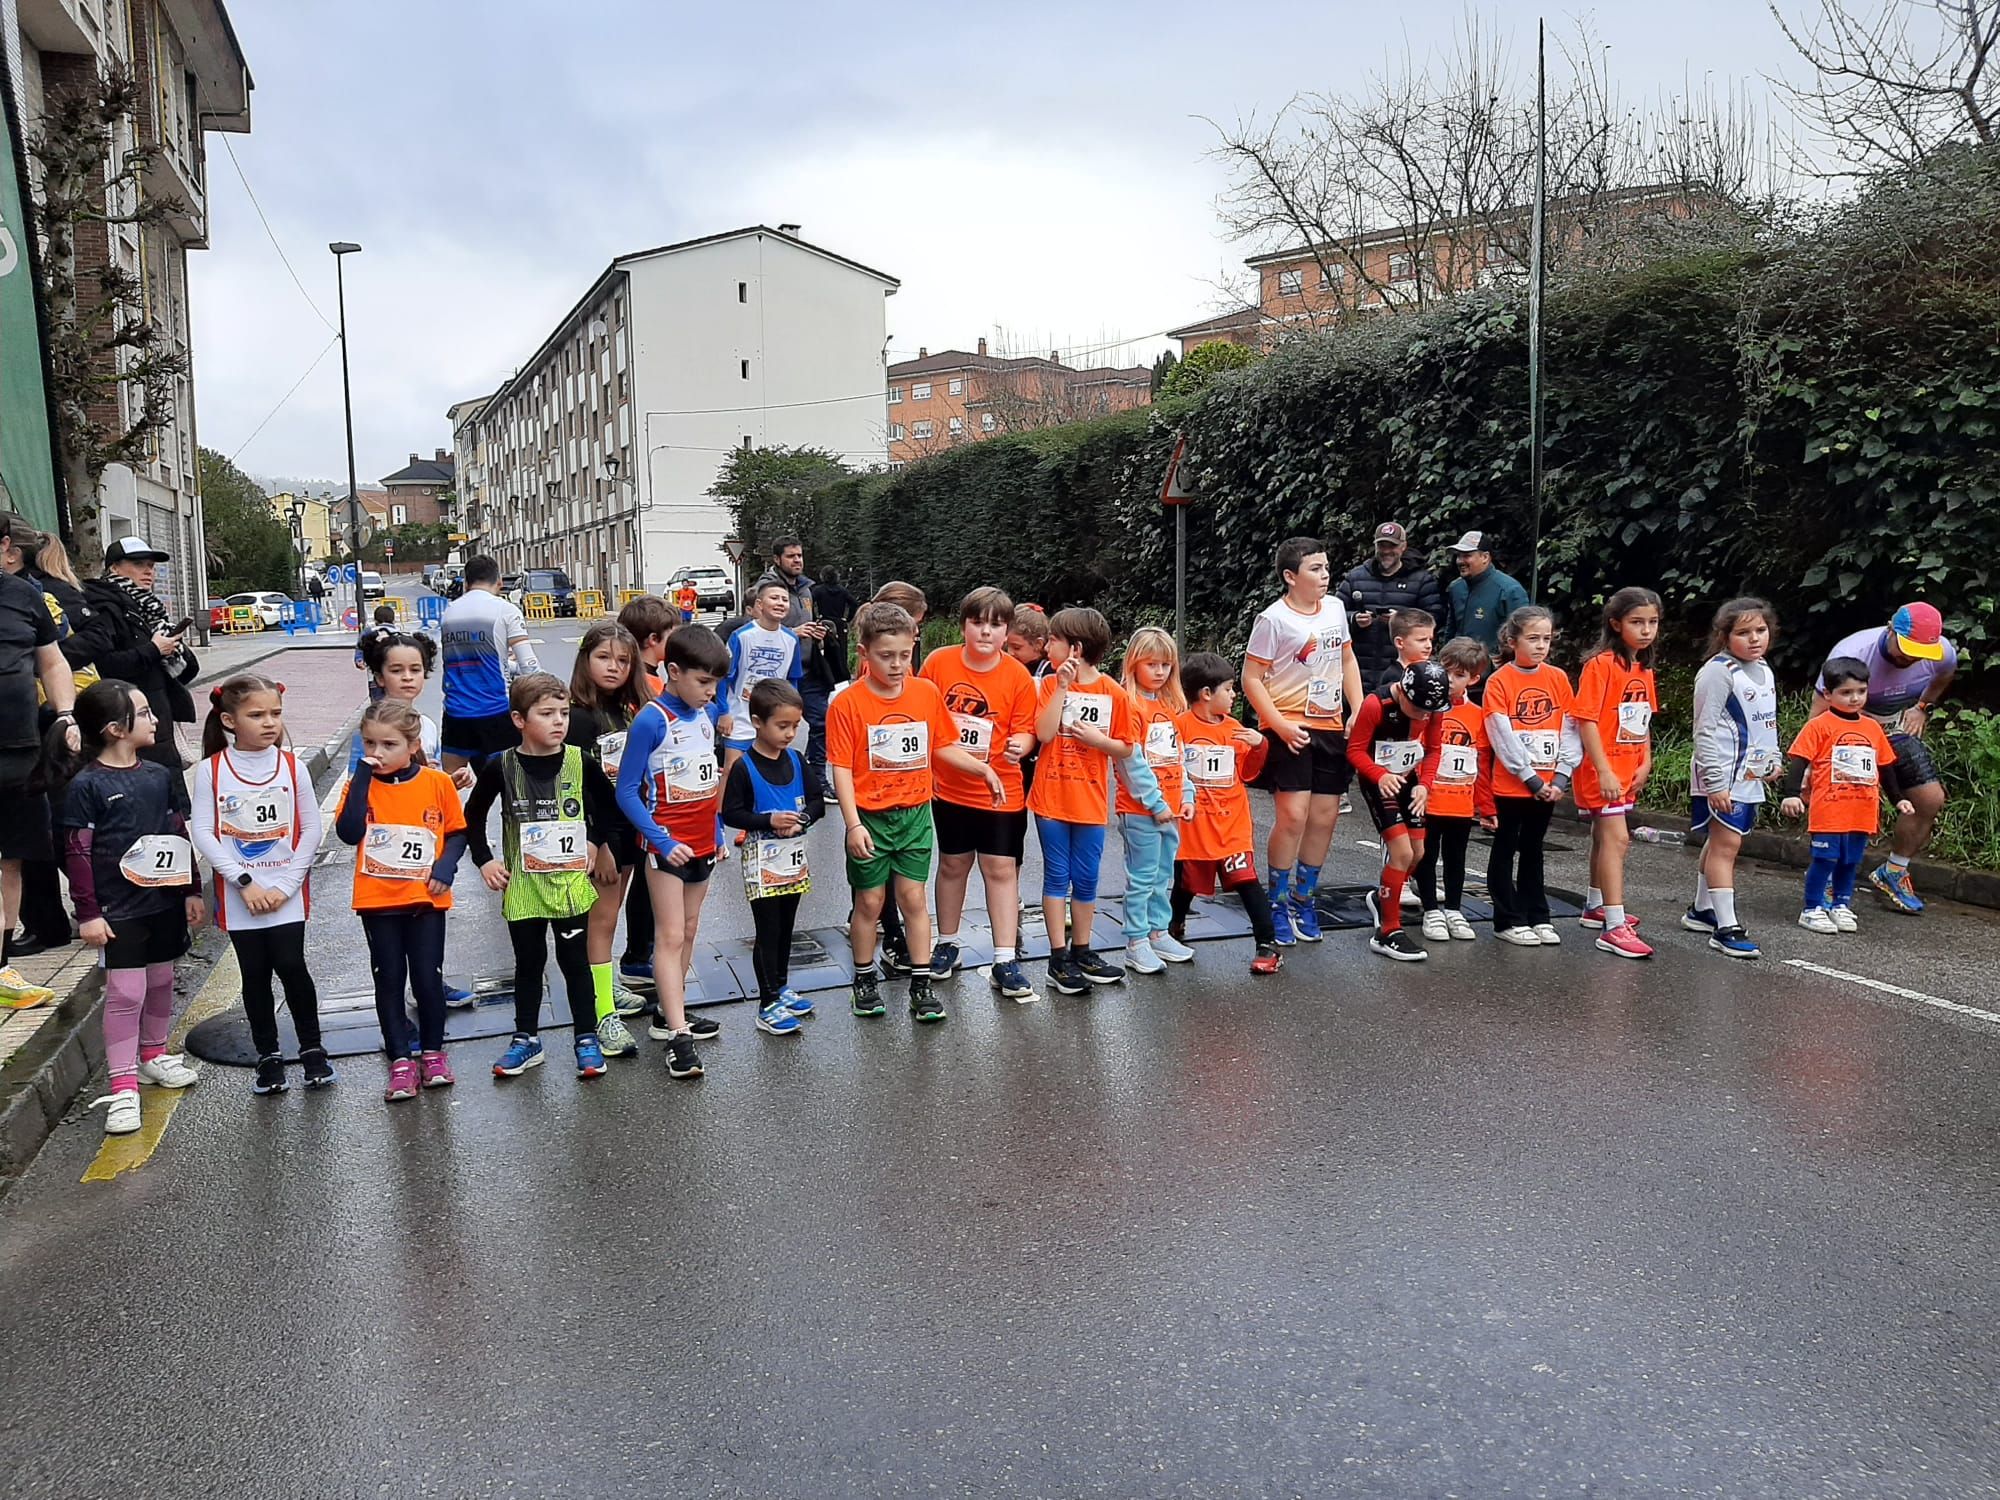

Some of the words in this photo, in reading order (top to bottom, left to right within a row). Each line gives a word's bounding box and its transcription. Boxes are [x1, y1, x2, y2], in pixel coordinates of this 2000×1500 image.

[1079, 706, 1099, 722] 28
[901, 736, 919, 753] 39
[960, 728, 979, 745] 38
[1543, 742, 1555, 755] 51
[1206, 758, 1219, 772] 11
[1402, 752, 1416, 766] 31
[1452, 758, 1465, 771] 17
[1861, 758, 1872, 771] 16
[699, 763, 713, 781] 37
[256, 804, 277, 823] 34
[401, 841, 423, 860] 25
[558, 836, 574, 854] 12
[155, 851, 174, 869] 27
[790, 850, 804, 866] 15
